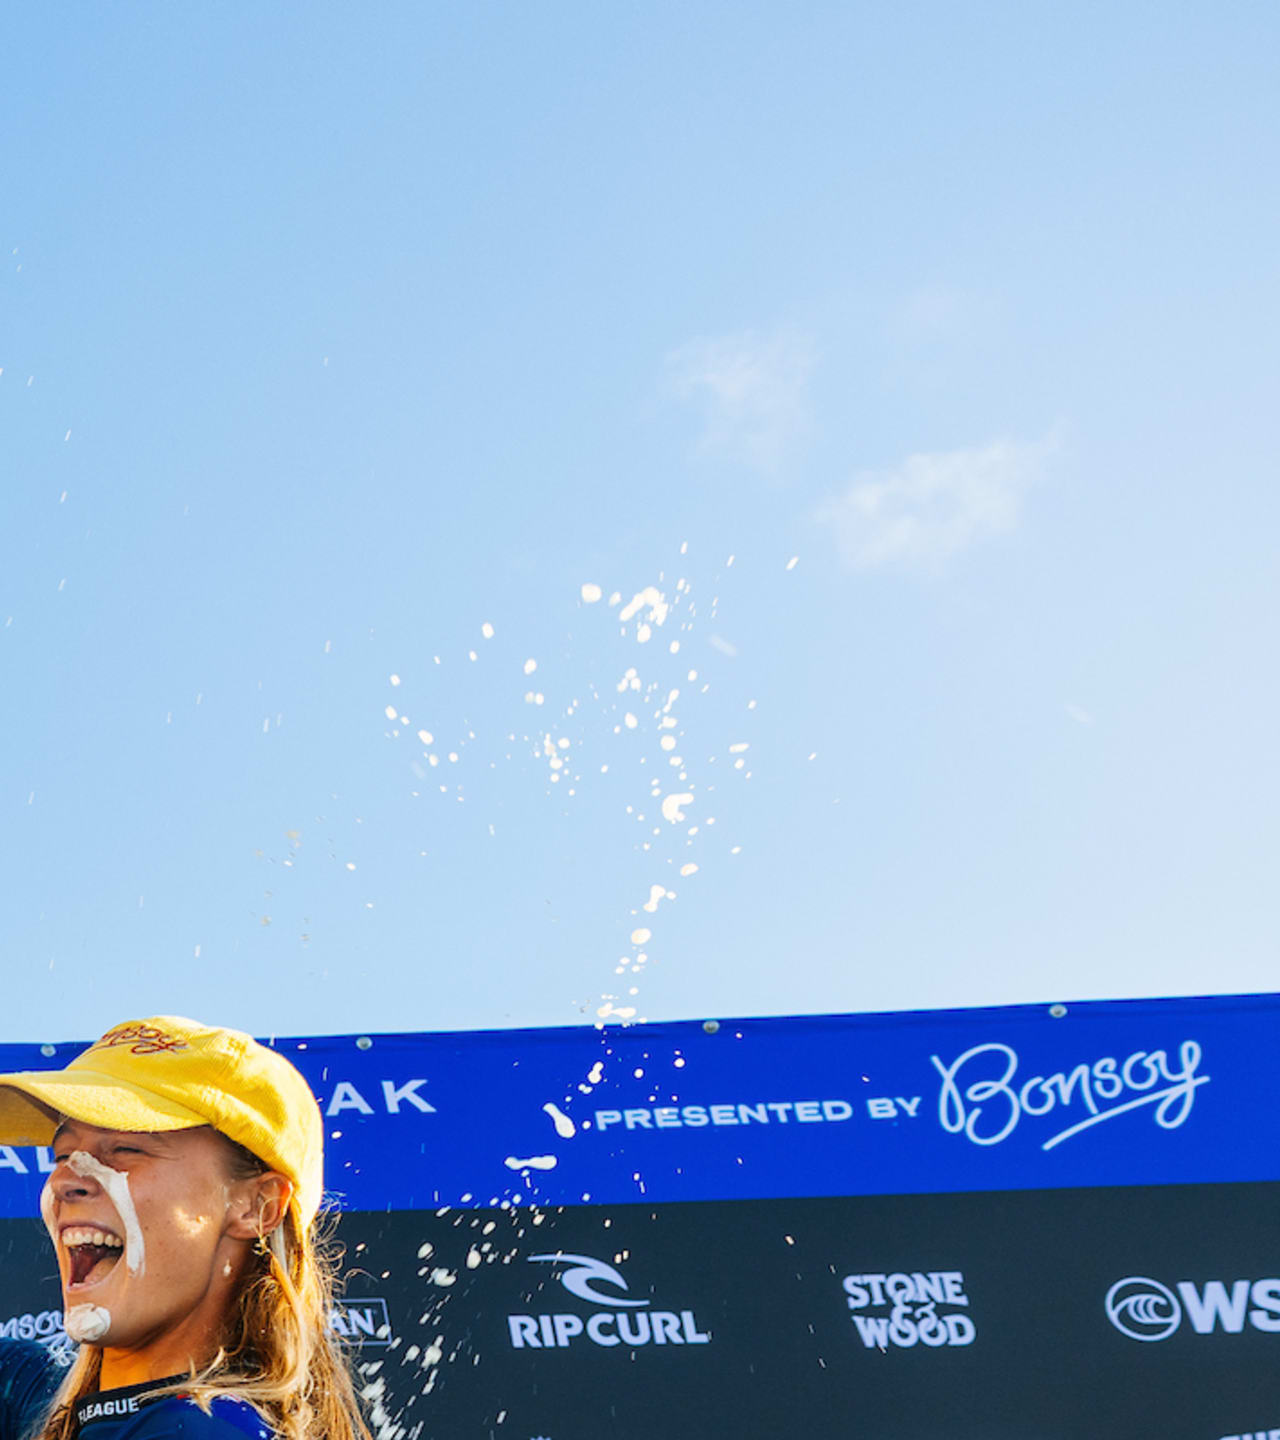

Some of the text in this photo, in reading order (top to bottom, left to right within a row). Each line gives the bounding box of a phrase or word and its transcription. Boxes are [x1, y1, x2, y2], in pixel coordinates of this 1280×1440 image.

[595, 1040, 1210, 1150] PRESENTED BY Bonsoy
[843, 1272, 968, 1310] STONE
[1177, 1279, 1280, 1335] WS
[508, 1311, 710, 1348] RIP CURL
